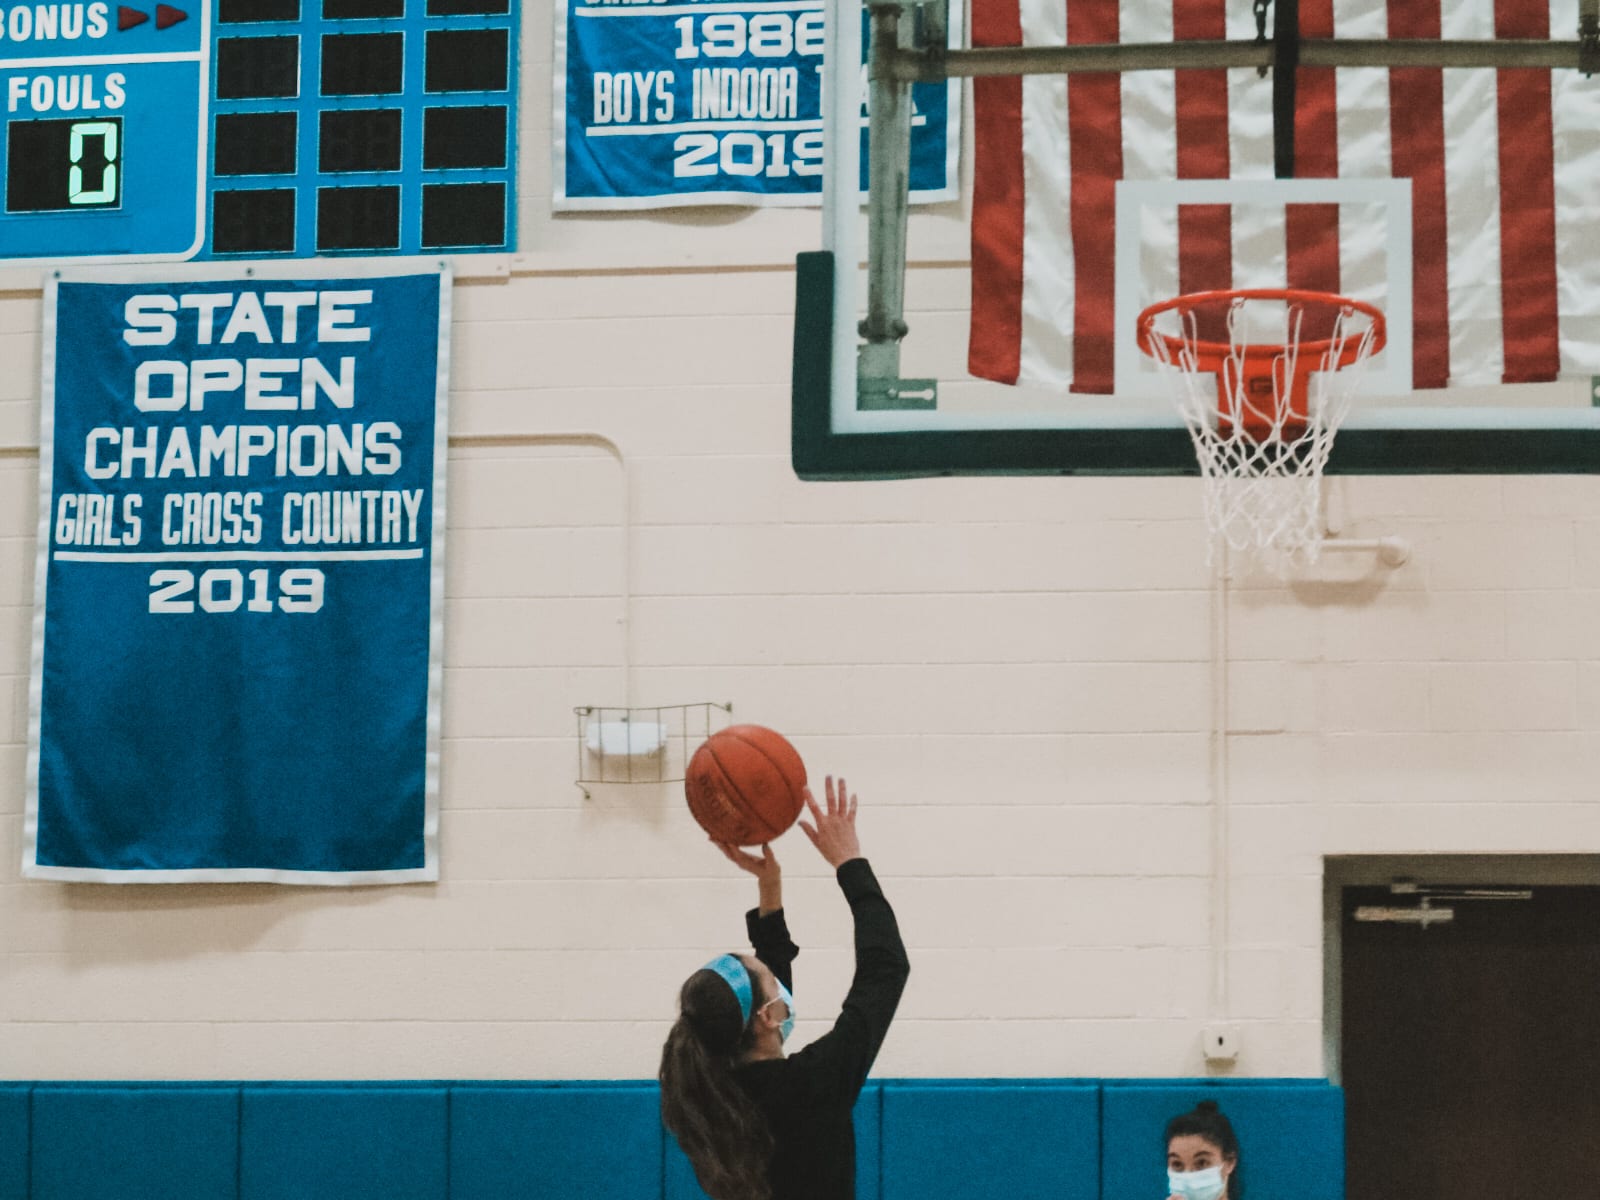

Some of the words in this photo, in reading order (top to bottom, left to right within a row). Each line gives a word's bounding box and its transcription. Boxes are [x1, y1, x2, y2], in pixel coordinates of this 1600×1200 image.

[0, 2, 109, 42] ONUS
[8, 72, 126, 112] FOULS
[593, 70, 675, 124] BOYS
[692, 67, 798, 121] INDOOR
[69, 122, 117, 204] 0
[673, 131, 823, 178] 2019
[123, 289, 373, 346] STATE
[134, 356, 356, 412] OPEN
[84, 421, 402, 479] CHAMPIONS
[55, 493, 143, 546] GIRLS
[161, 491, 263, 545] CROSS
[281, 488, 425, 544] COUNTRY
[148, 568, 326, 614] 2019
